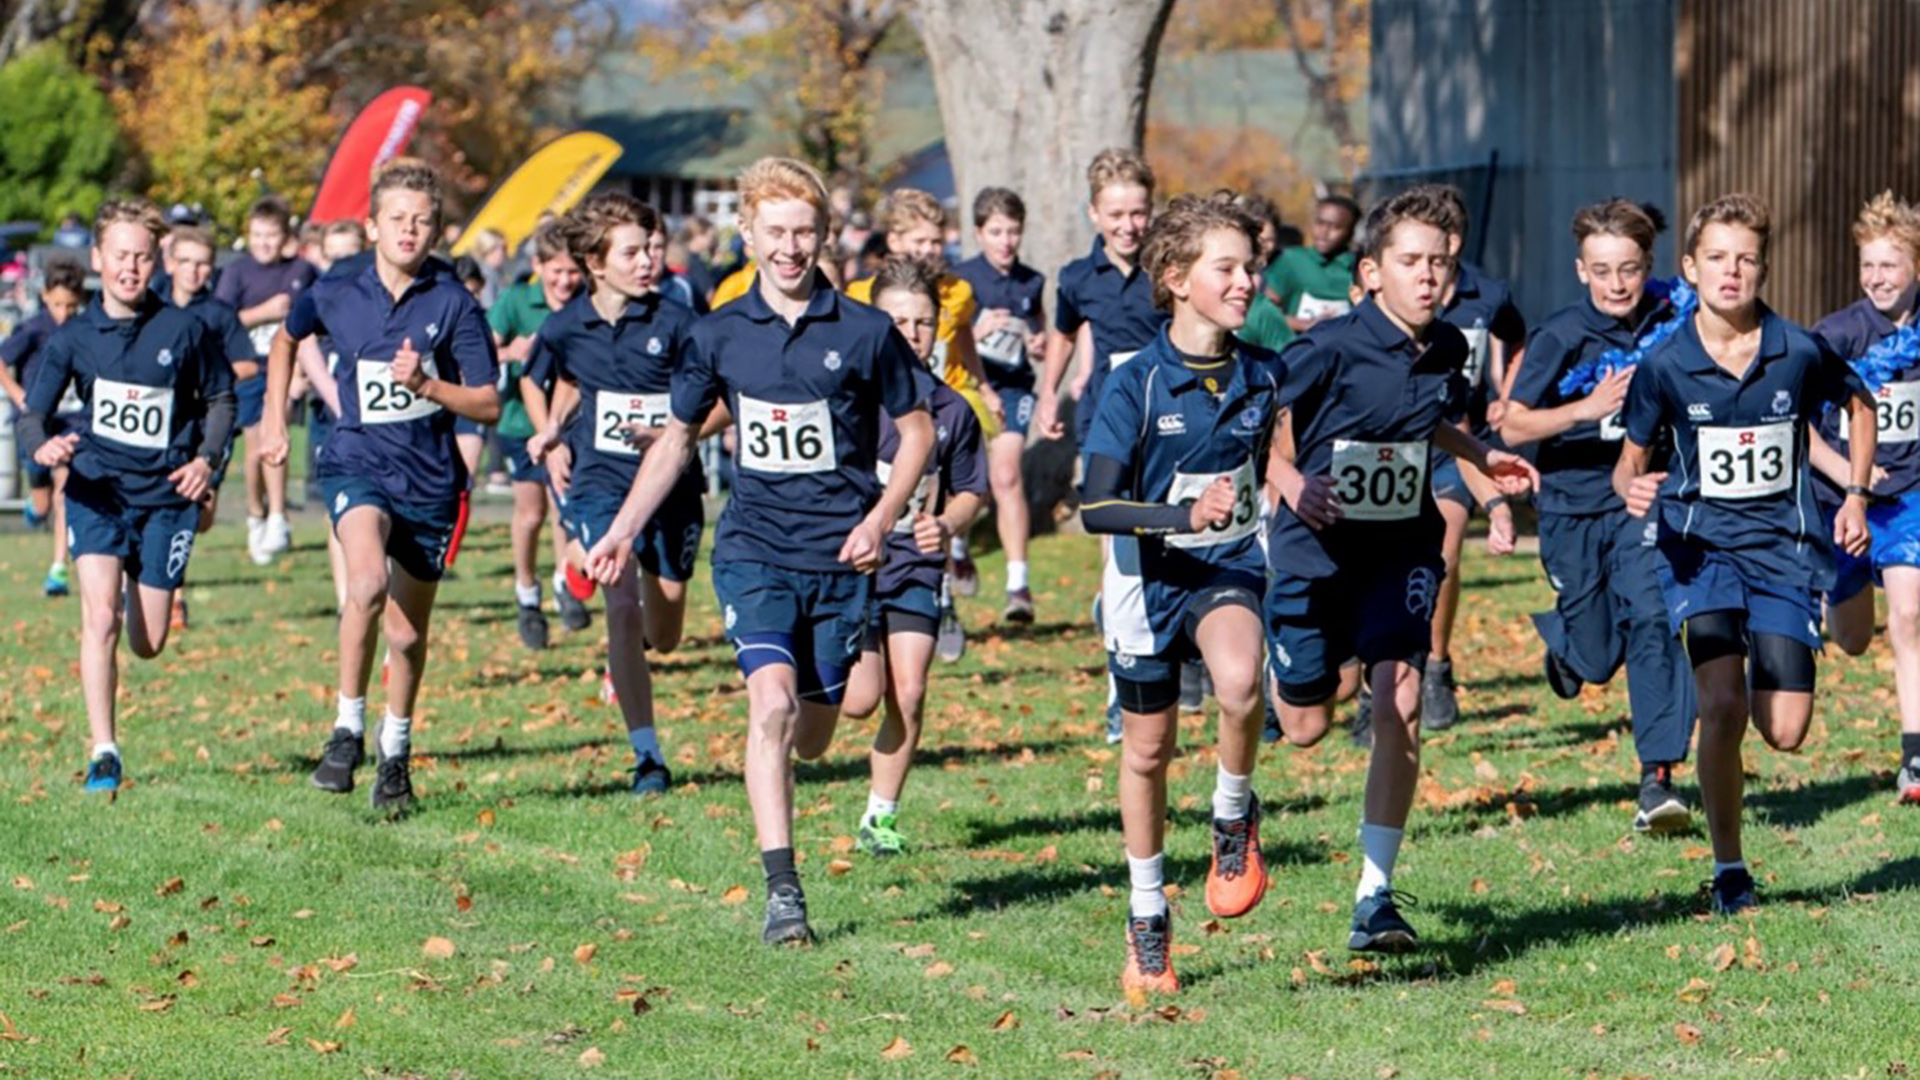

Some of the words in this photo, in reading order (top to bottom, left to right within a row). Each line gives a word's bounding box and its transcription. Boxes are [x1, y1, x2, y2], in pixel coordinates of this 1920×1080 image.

[365, 381, 421, 411] 25
[99, 399, 163, 437] 260
[748, 421, 823, 461] 316
[1338, 465, 1419, 506] 303
[1710, 446, 1783, 486] 313
